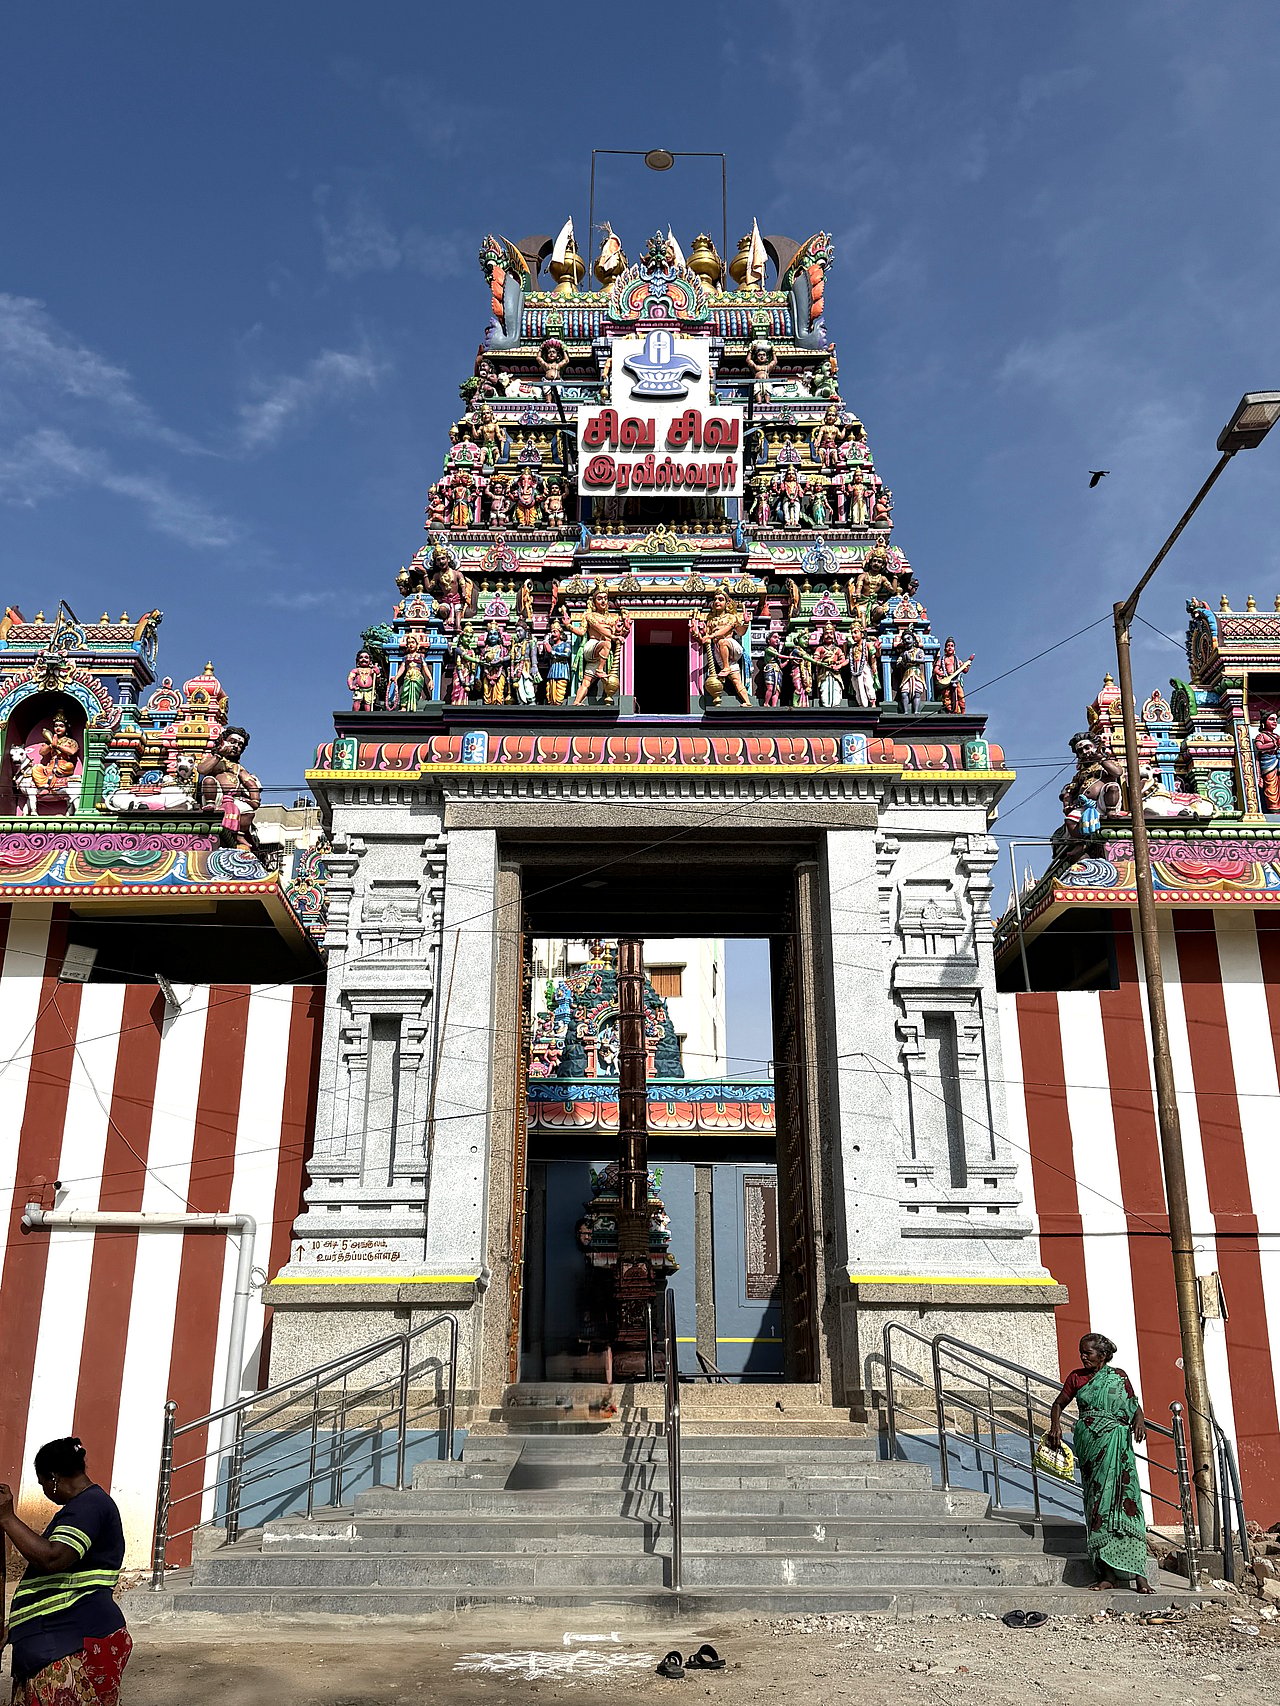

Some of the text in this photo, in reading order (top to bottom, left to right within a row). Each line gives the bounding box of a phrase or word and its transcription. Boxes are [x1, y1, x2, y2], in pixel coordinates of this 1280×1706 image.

[583, 409, 740, 447] சிவ சிவ
[583, 453, 739, 490] இரவீஸ்வரர்
